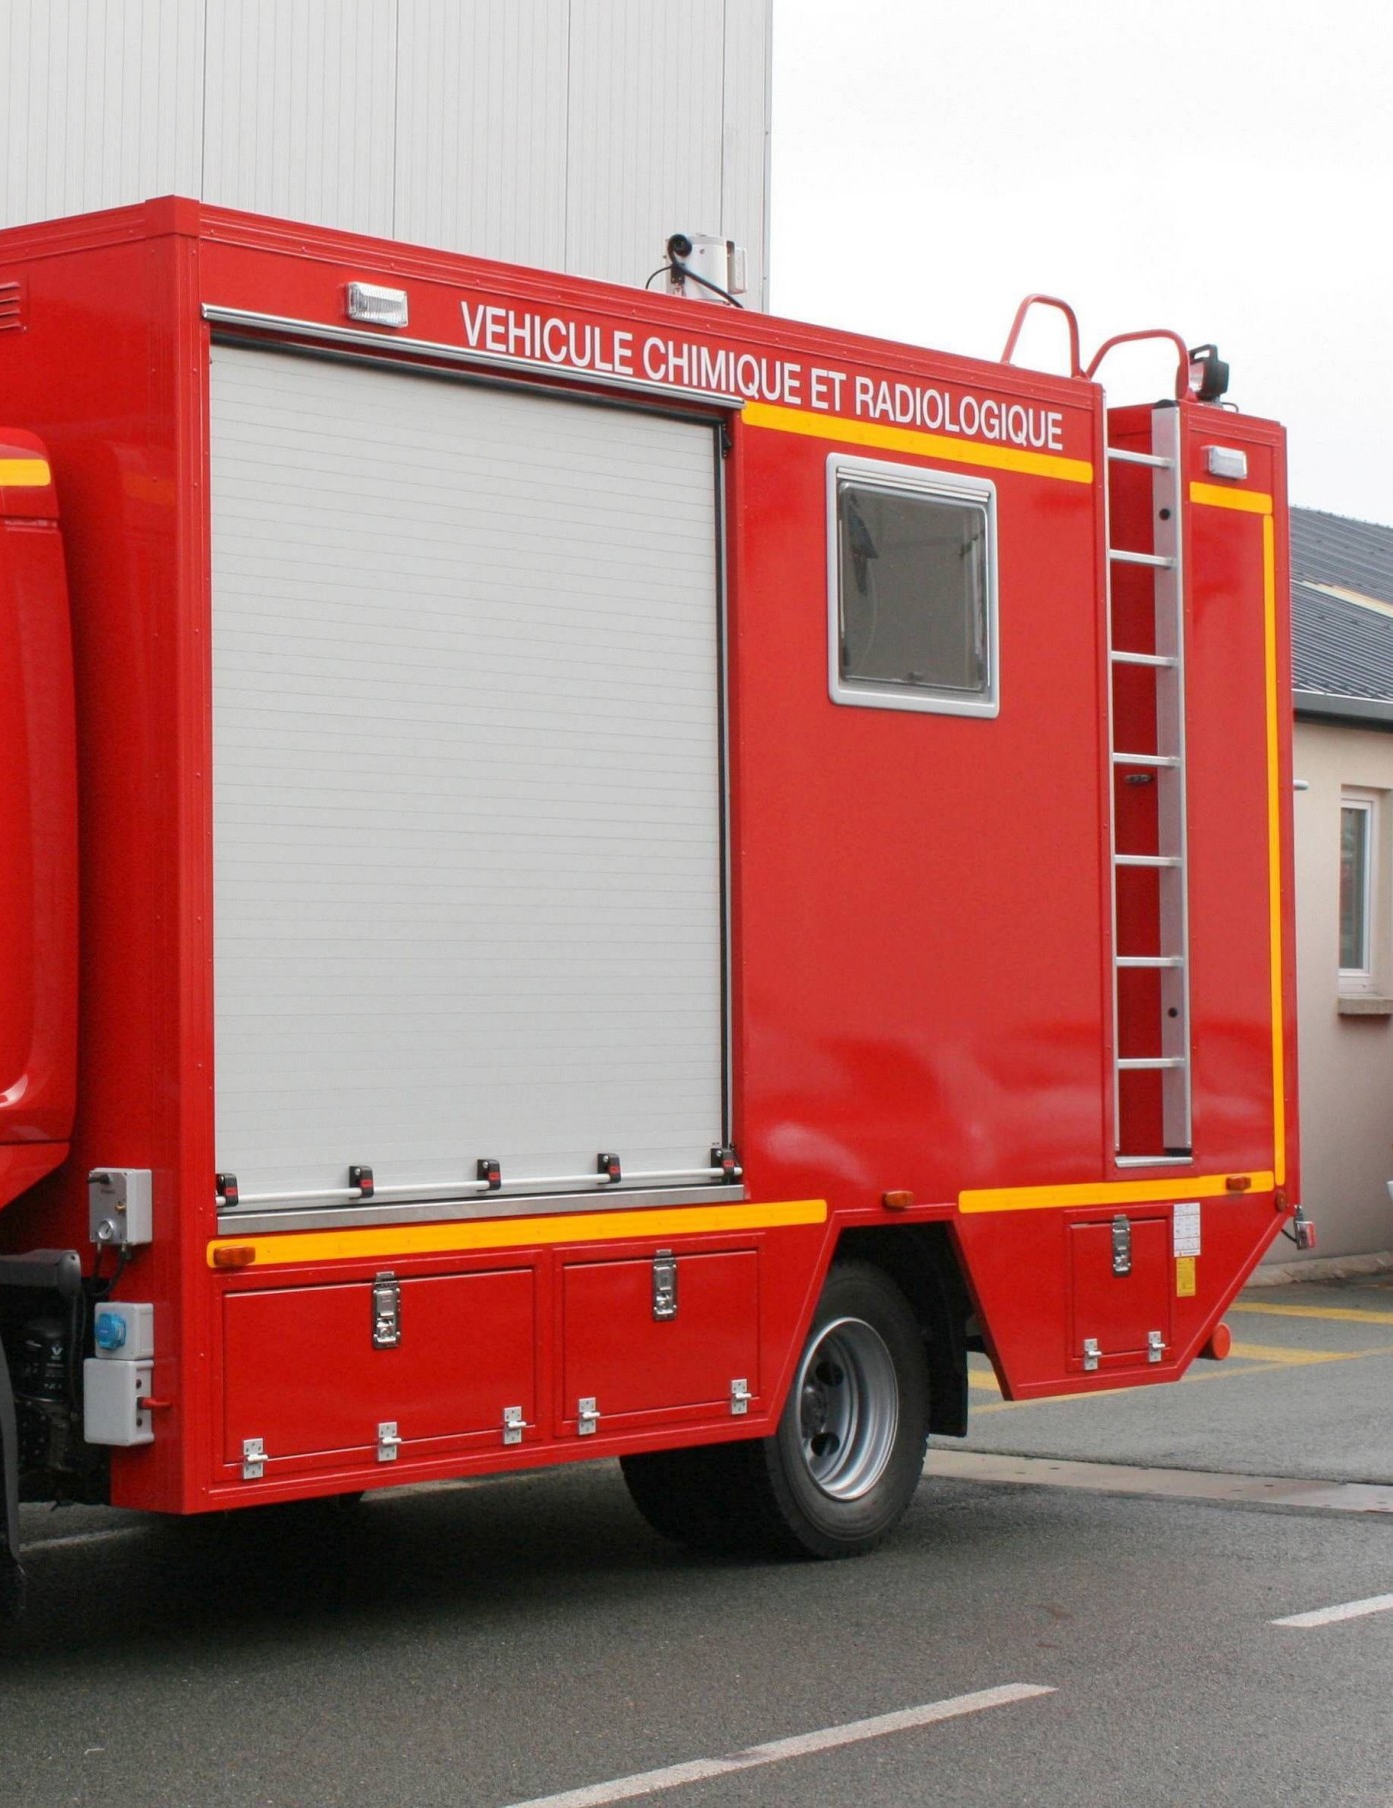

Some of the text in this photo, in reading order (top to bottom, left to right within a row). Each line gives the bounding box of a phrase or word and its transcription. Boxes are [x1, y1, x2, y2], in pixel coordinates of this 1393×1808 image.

[461, 301, 1063, 451] VEHICULE CHIMIQUE ET RADIOLOGIQUE
